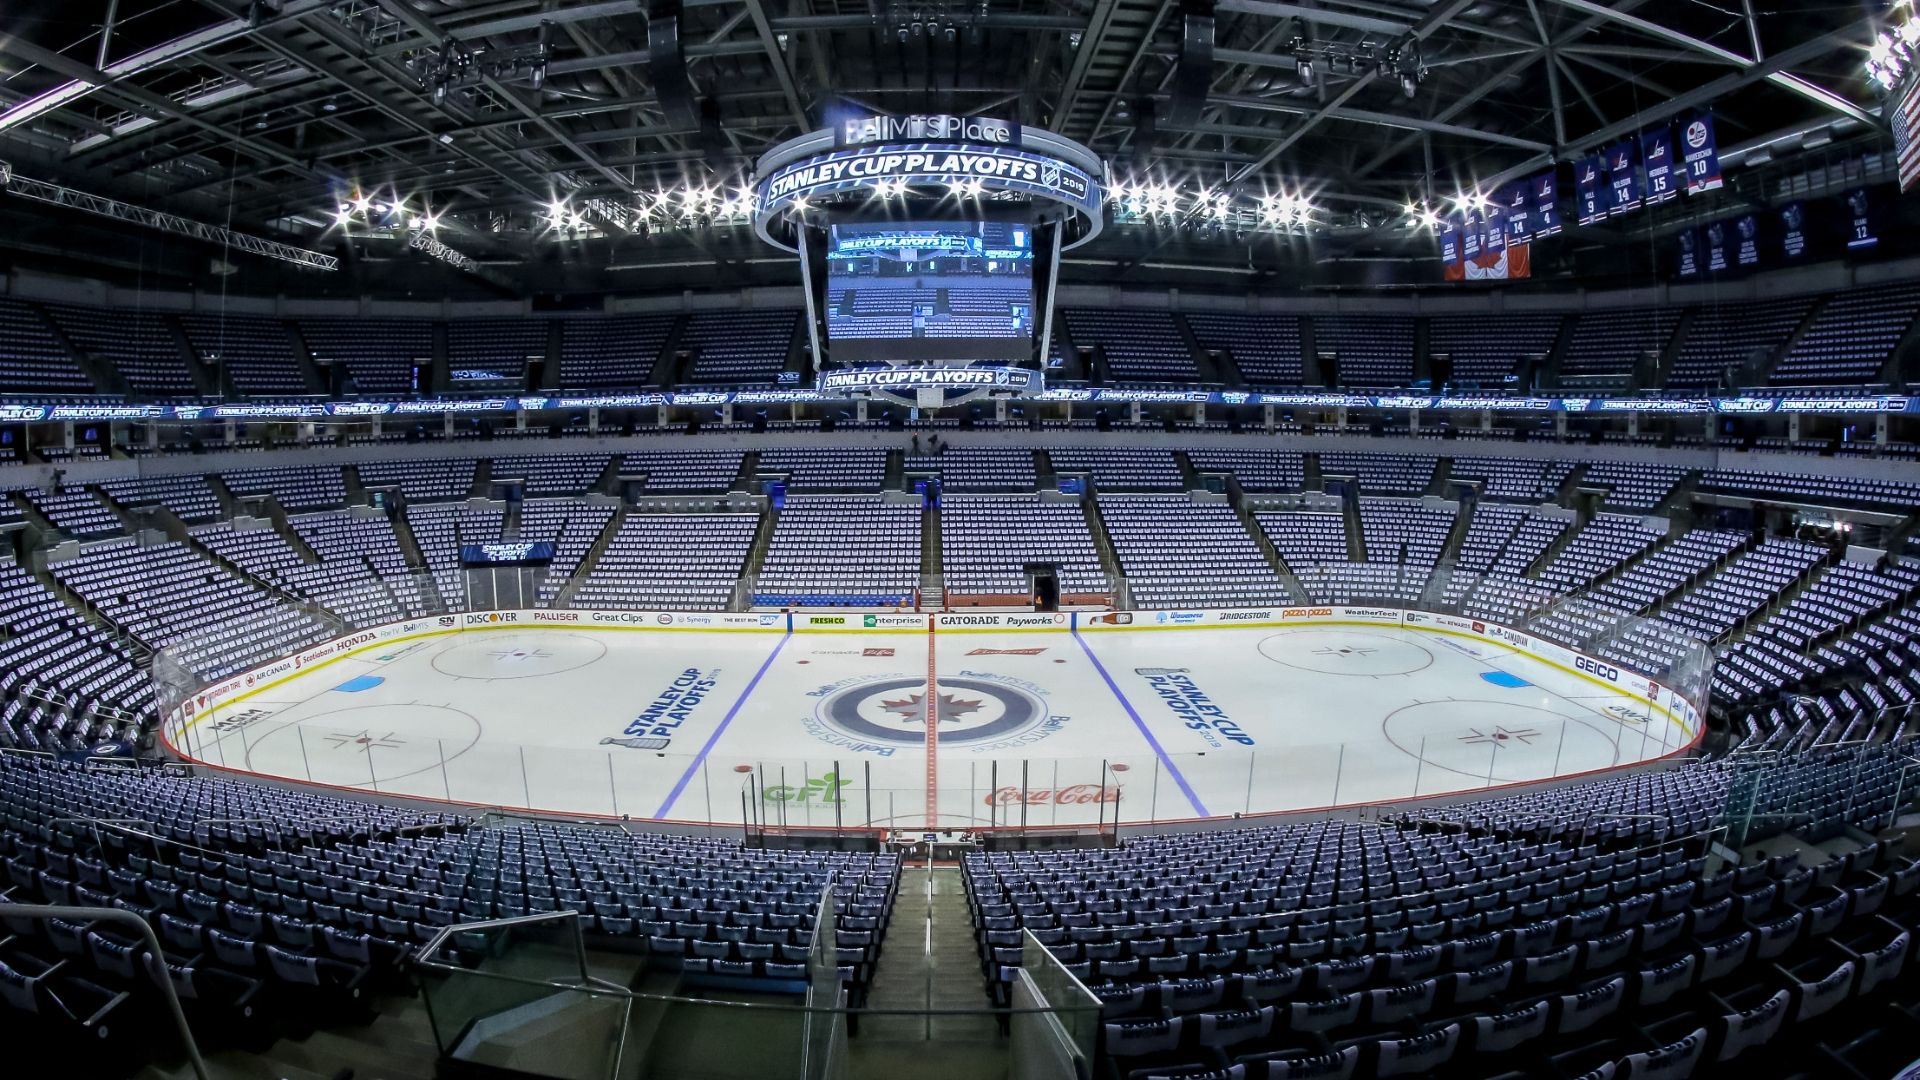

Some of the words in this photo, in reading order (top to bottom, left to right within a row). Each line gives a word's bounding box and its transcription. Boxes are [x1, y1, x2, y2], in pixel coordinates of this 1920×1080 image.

[948, 117, 1010, 142] Place
[1694, 160, 1707, 176] 10
[770, 161, 849, 200] STANLEY
[848, 157, 902, 177] CUP
[904, 154, 1037, 180] PLAYOFFS
[1063, 177, 1084, 192] 2019
[1654, 177, 1666, 192] 15
[1617, 188, 1630, 202] 14
[1588, 201, 1594, 213] 9
[1544, 213, 1550, 224] 4
[1514, 222, 1524, 234] 14
[1856, 226, 1867, 239] 12
[827, 373, 875, 387] STANLEY
[874, 372, 908, 385] CUP
[910, 370, 994, 384] PLAYOFFS
[1011, 376, 1028, 384] 2019
[218, 408, 252, 416] STANLEY
[266, 407, 302, 415] PLAYOFFS
[1753, 401, 1771, 410] CUP
[1782, 402, 1817, 410] STANLEY
[1816, 402, 1834, 410] CUP
[1834, 401, 1878, 409] PLAYOFFS
[23, 408, 43, 418] CUP
[54, 409, 88, 417] STANLEY
[88, 409, 105, 417] CUP
[467, 612, 518, 624] DISCOVER
[534, 612, 579, 621] PALLISER
[592, 612, 620, 623] Great
[621, 612, 643, 625] Clips
[1219, 611, 1271, 621] BRIDGESTONE
[1283, 609, 1306, 619] pizza
[1307, 608, 1332, 618] pizza
[1345, 609, 1397, 617] WeatherTech
[438, 616, 456, 625] SN
[687, 616, 712, 625] Synergy
[760, 616, 776, 624] SAP
[941, 616, 1000, 625] GATORADE
[1007, 617, 1052, 627] Payworks
[336, 632, 377, 652] HONDA
[1504, 631, 1529, 648] CANADIAN
[303, 647, 335, 663] Scotiabank
[256, 671, 267, 681] AIR
[267, 663, 291, 677] CANADA
[1575, 656, 1618, 681] GEICO
[624, 684, 681, 737] STANLEY
[673, 667, 702, 687] CUP
[649, 678, 717, 737] PLAYOFFS
[1145, 675, 1212, 732] PLAYOFFS
[1167, 673, 1227, 721] STANLEY
[1212, 718, 1256, 746] CUP
[207, 708, 264, 731] MGM
[763, 779, 848, 803] GFL
